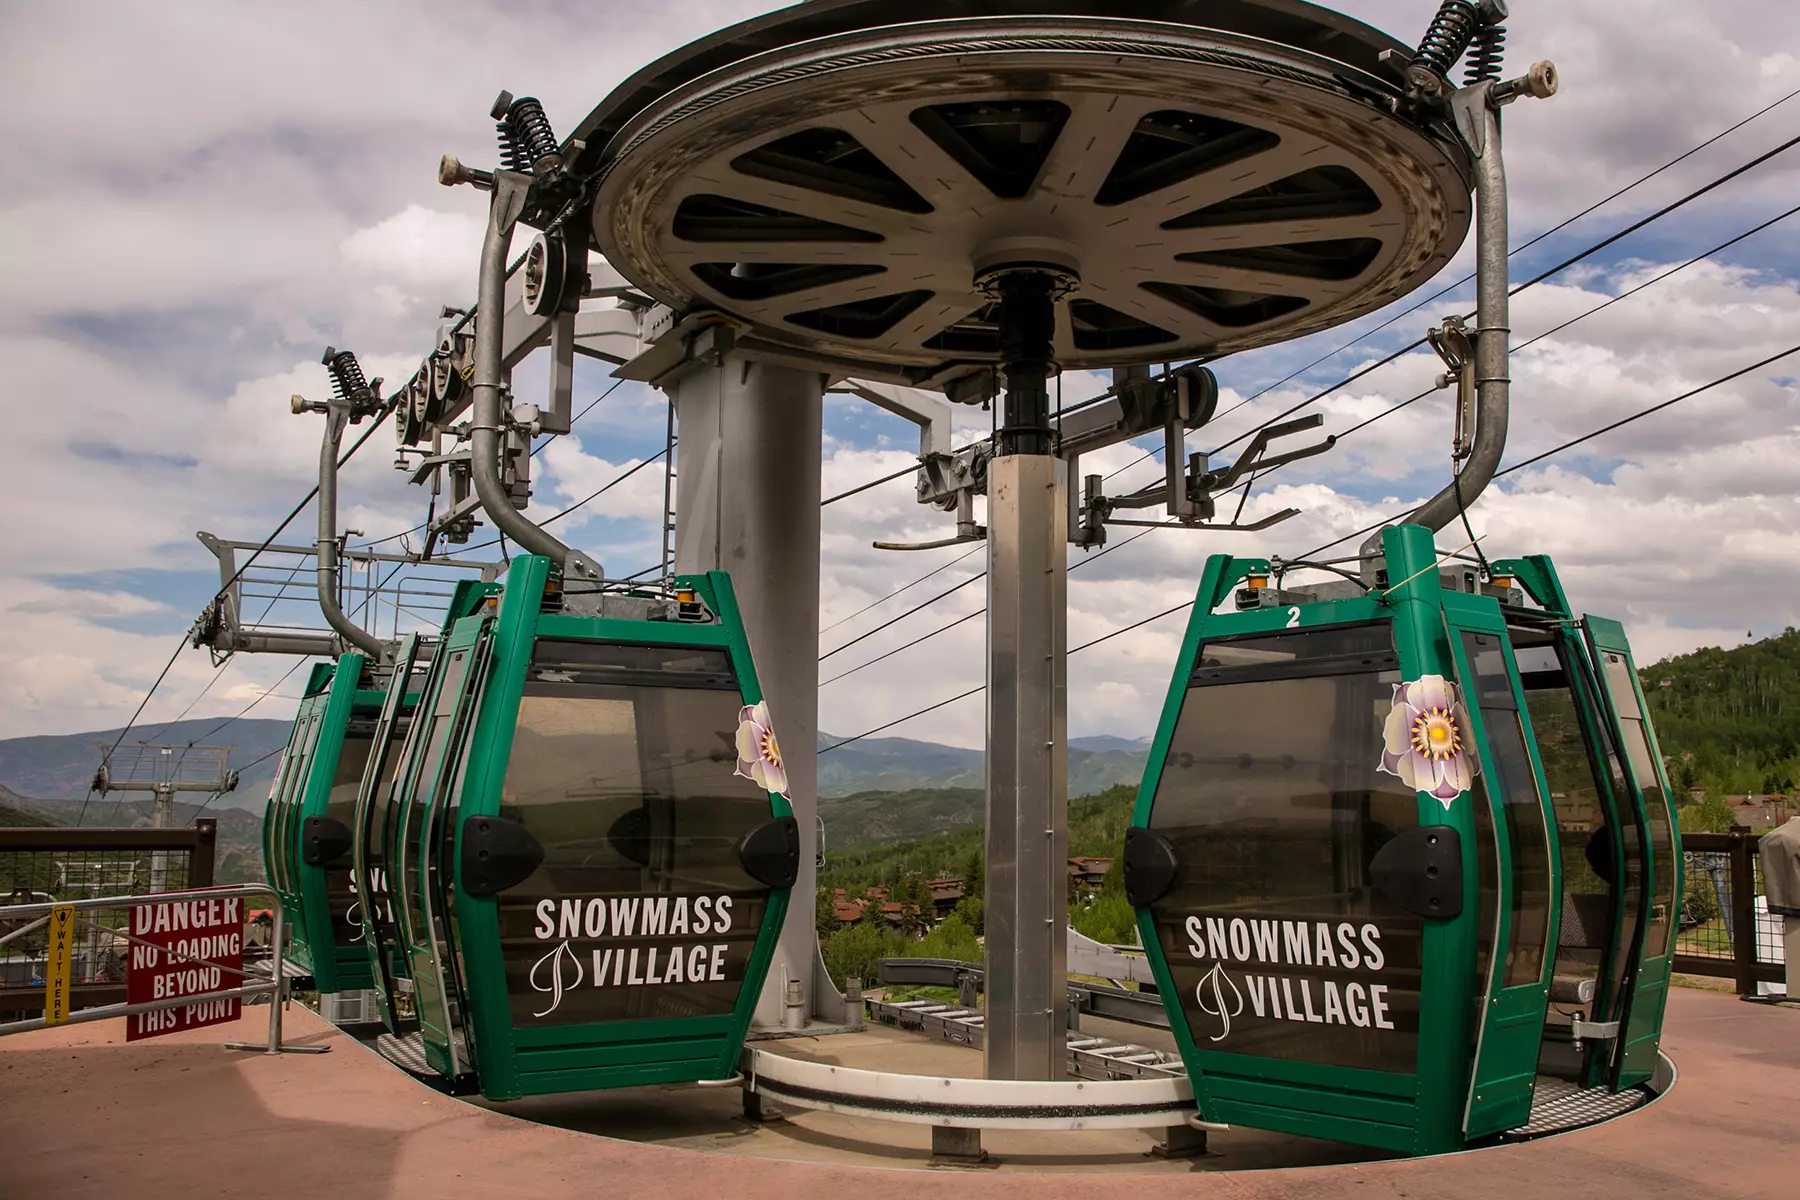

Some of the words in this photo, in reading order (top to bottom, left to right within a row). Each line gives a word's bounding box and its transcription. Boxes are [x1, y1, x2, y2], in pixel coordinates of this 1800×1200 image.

[1286, 606, 1301, 628] 2
[136, 898, 239, 936] DANGER
[534, 895, 733, 939] SNOWMASS
[56, 931, 67, 971] WAIT
[133, 945, 158, 970] NO
[167, 932, 240, 965] LOADING
[1185, 915, 1385, 970] SNOWMASS
[153, 967, 221, 999] BEYOND
[592, 944, 728, 987] VILLAGE
[54, 979, 63, 1019] HERE
[138, 1008, 177, 1034] THIS
[186, 999, 233, 1024] POINT
[1245, 975, 1395, 1029] VILLAGE
